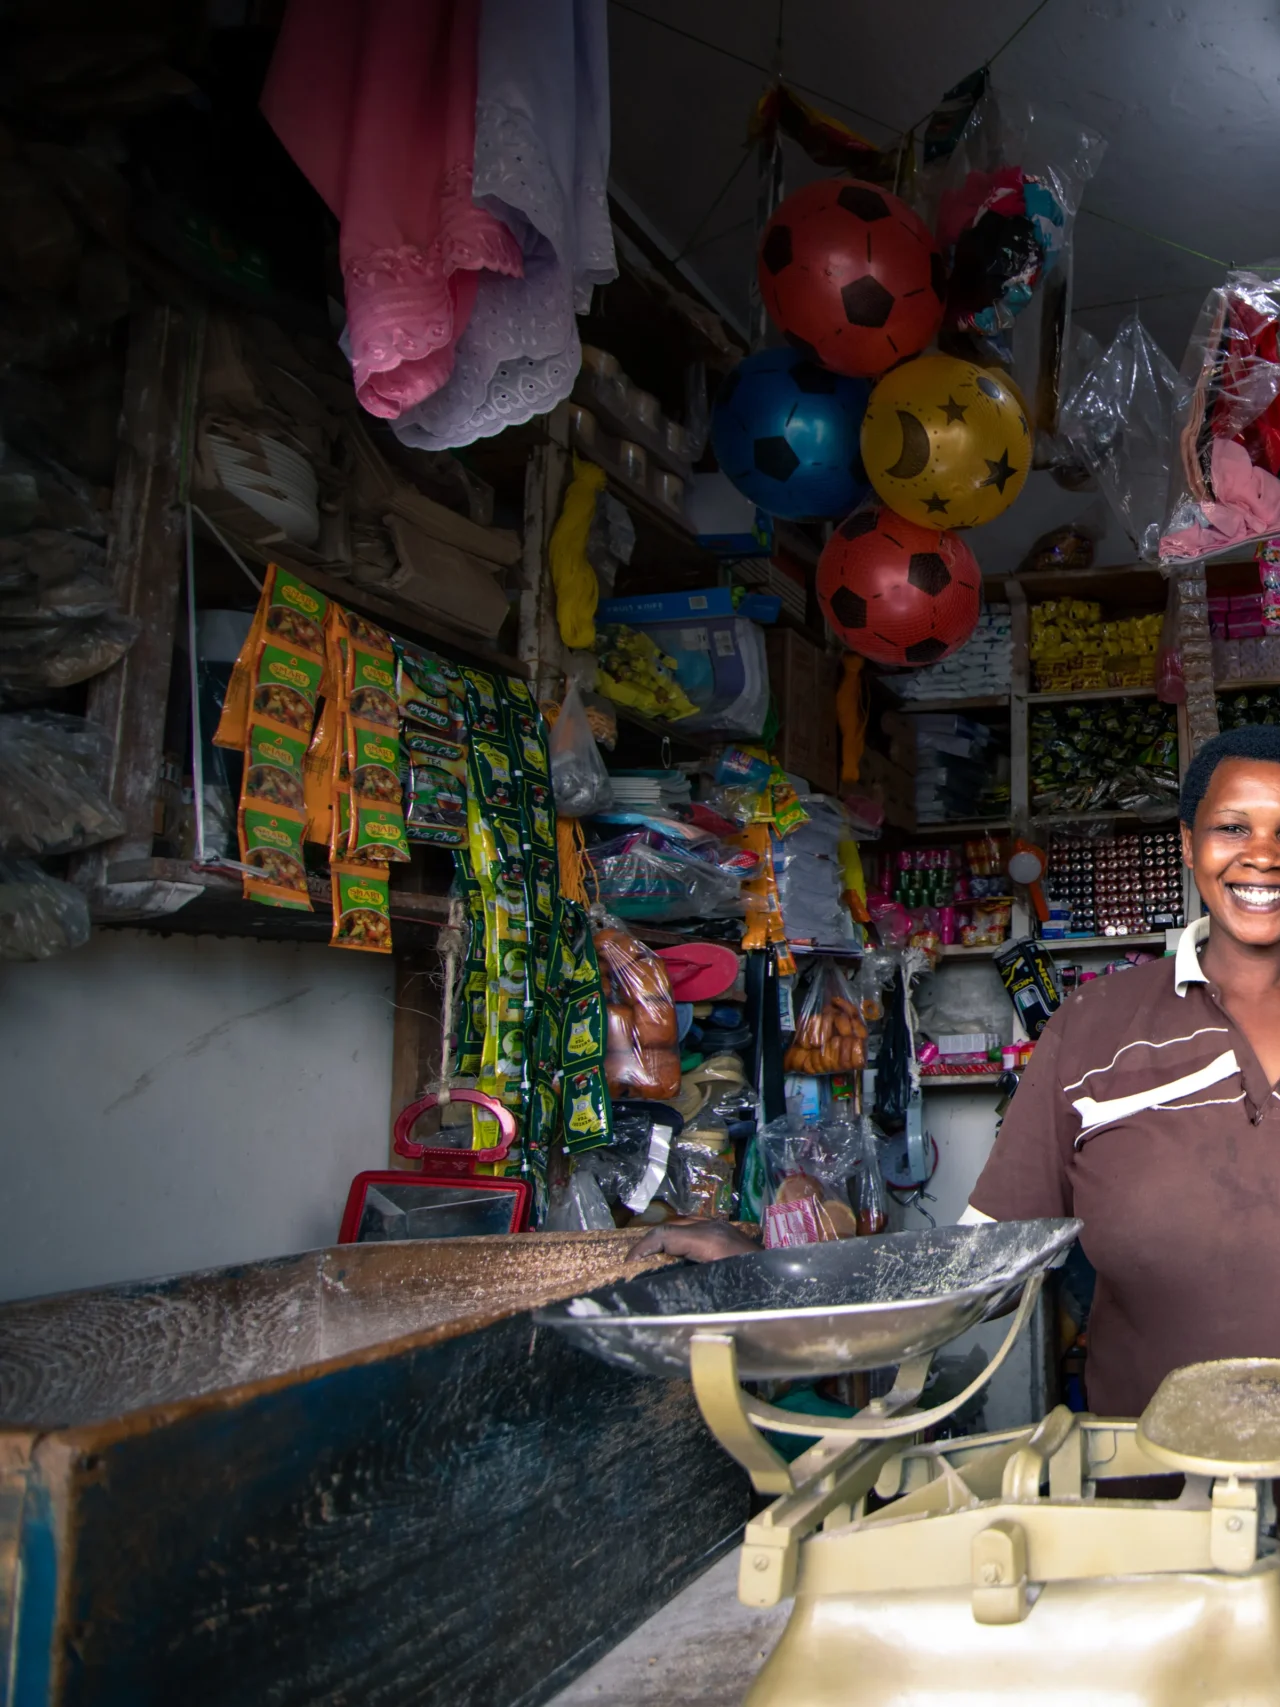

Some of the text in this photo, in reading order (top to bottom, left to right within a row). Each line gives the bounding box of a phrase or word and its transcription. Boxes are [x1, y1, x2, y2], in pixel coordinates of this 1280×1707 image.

[269, 662, 308, 684] SMART
[406, 702, 449, 726] Cha Cha
[364, 744, 394, 758] SMART
[410, 739, 459, 758] Cha Cha
[426, 756, 442, 766] TEA
[366, 822, 400, 834] SMART
[405, 828, 434, 838] Cha
[433, 831, 461, 842] Cha
[349, 887, 382, 901] SMART
[1011, 975, 1035, 993] NICE
[1034, 957, 1059, 1002] NICE
